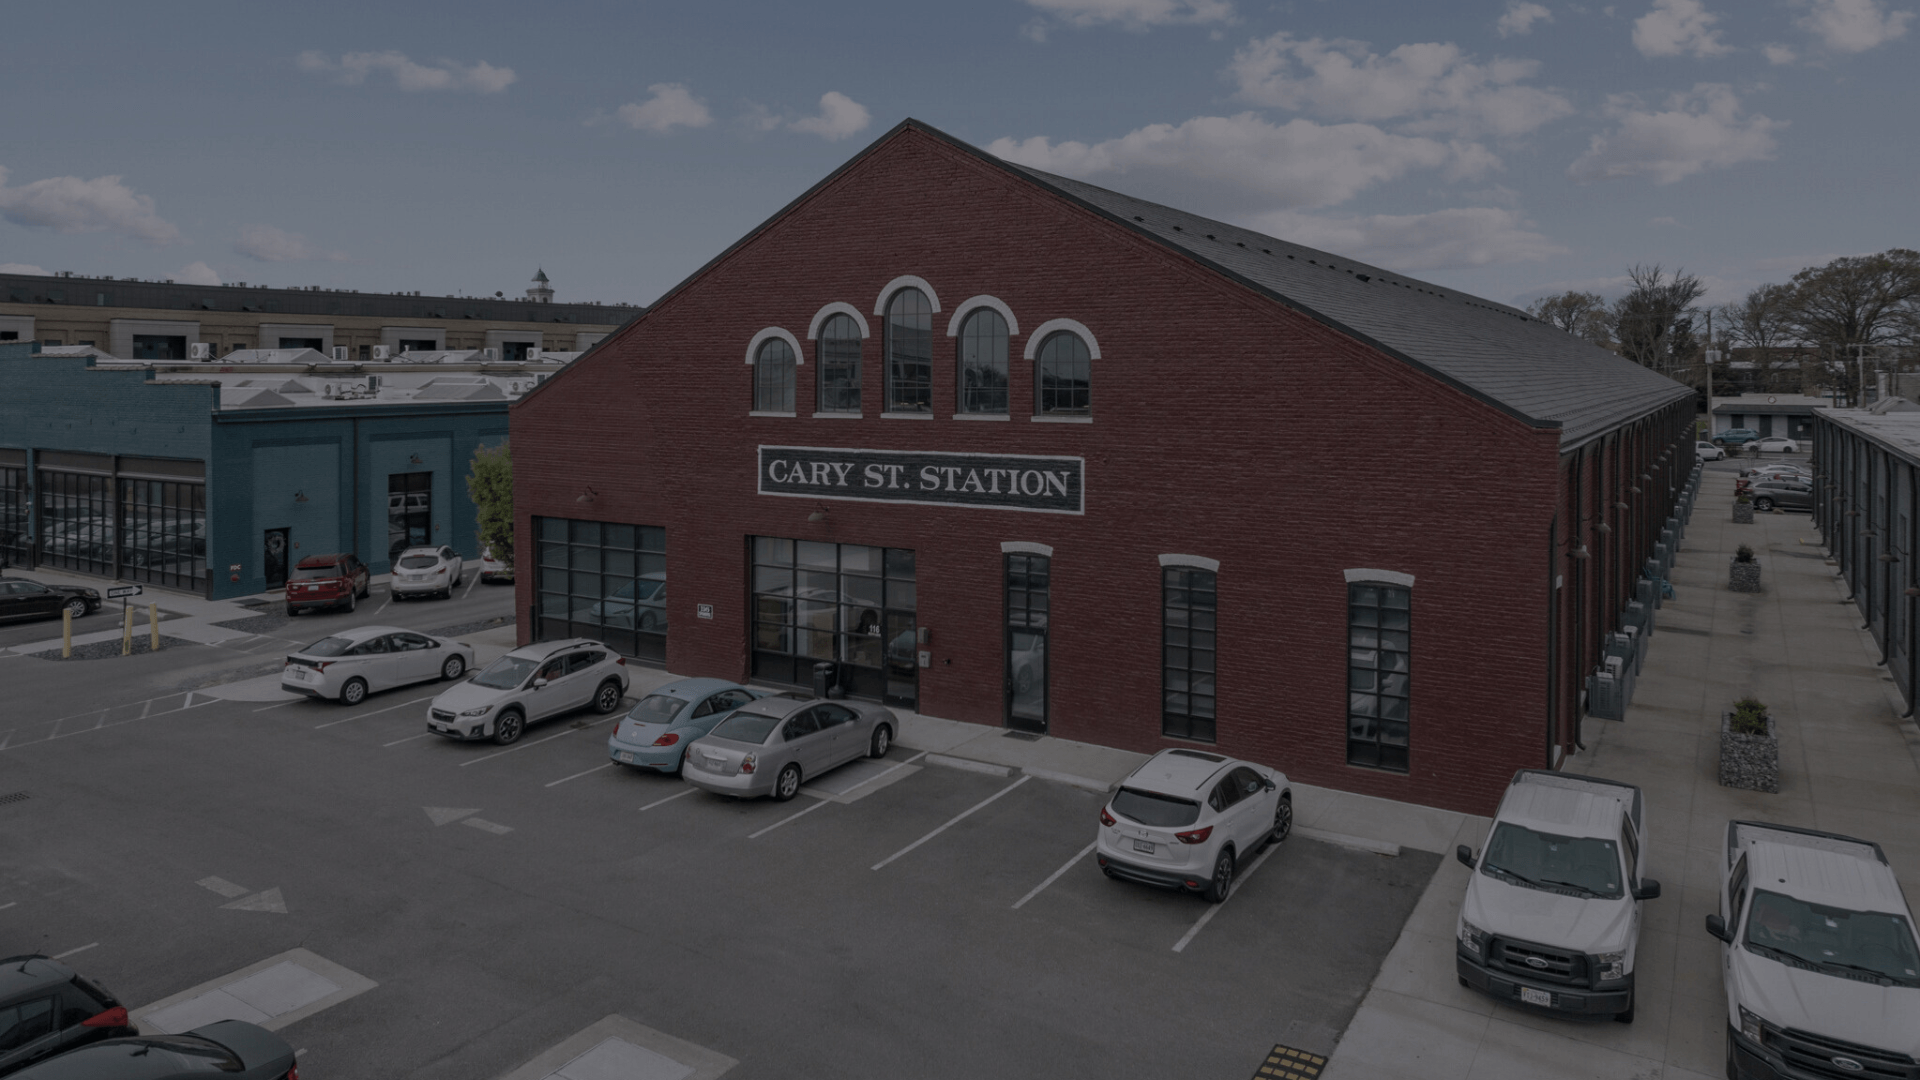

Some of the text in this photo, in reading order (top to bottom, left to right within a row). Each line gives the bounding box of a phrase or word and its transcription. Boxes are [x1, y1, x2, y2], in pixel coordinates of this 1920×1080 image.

[768, 459, 1071, 498] CARY ST. STATION
[869, 624, 880, 634] 116
